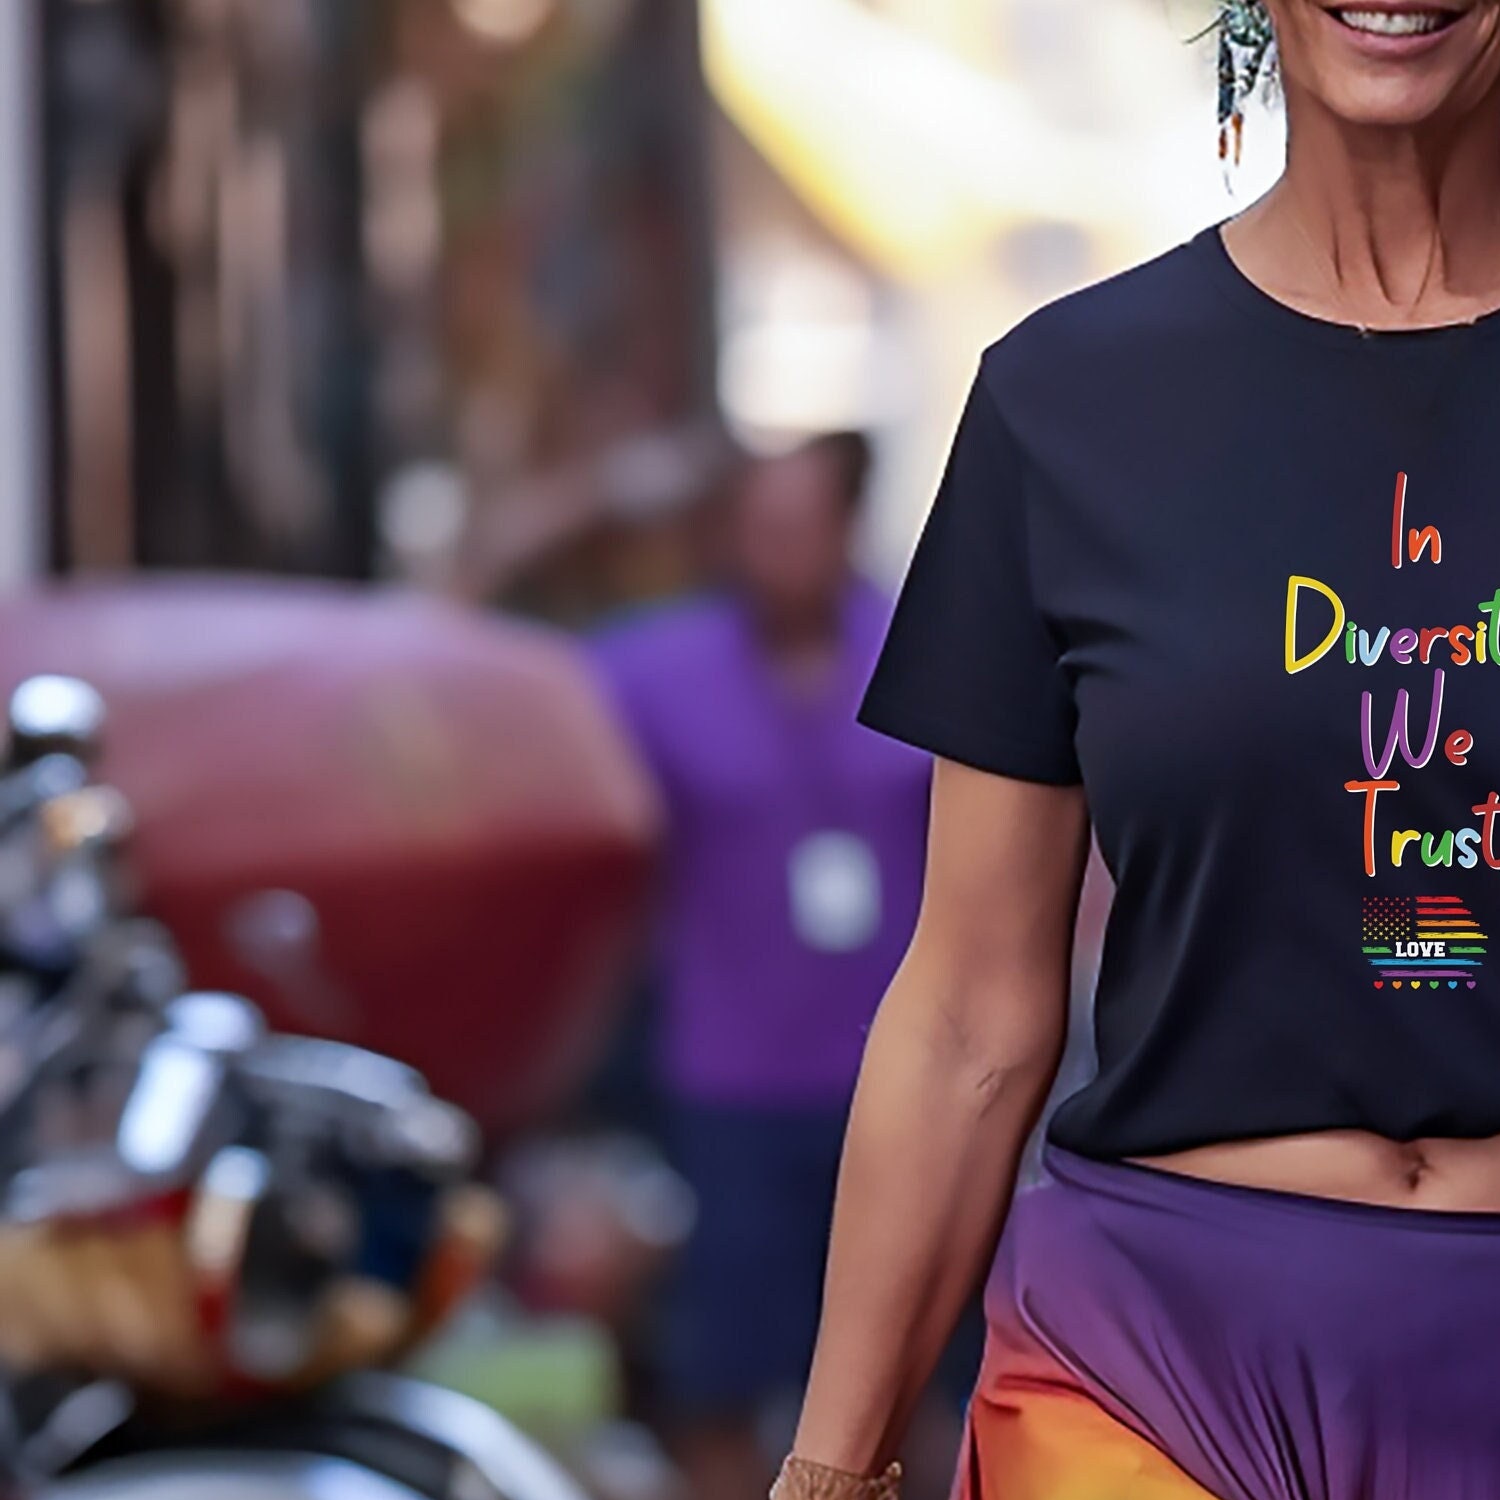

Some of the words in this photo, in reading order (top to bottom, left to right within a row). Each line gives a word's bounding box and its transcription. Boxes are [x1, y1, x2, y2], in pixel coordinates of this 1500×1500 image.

[1391, 471, 1442, 570] In
[1360, 668, 1474, 779] We
[1395, 941, 1446, 957] LOVE
